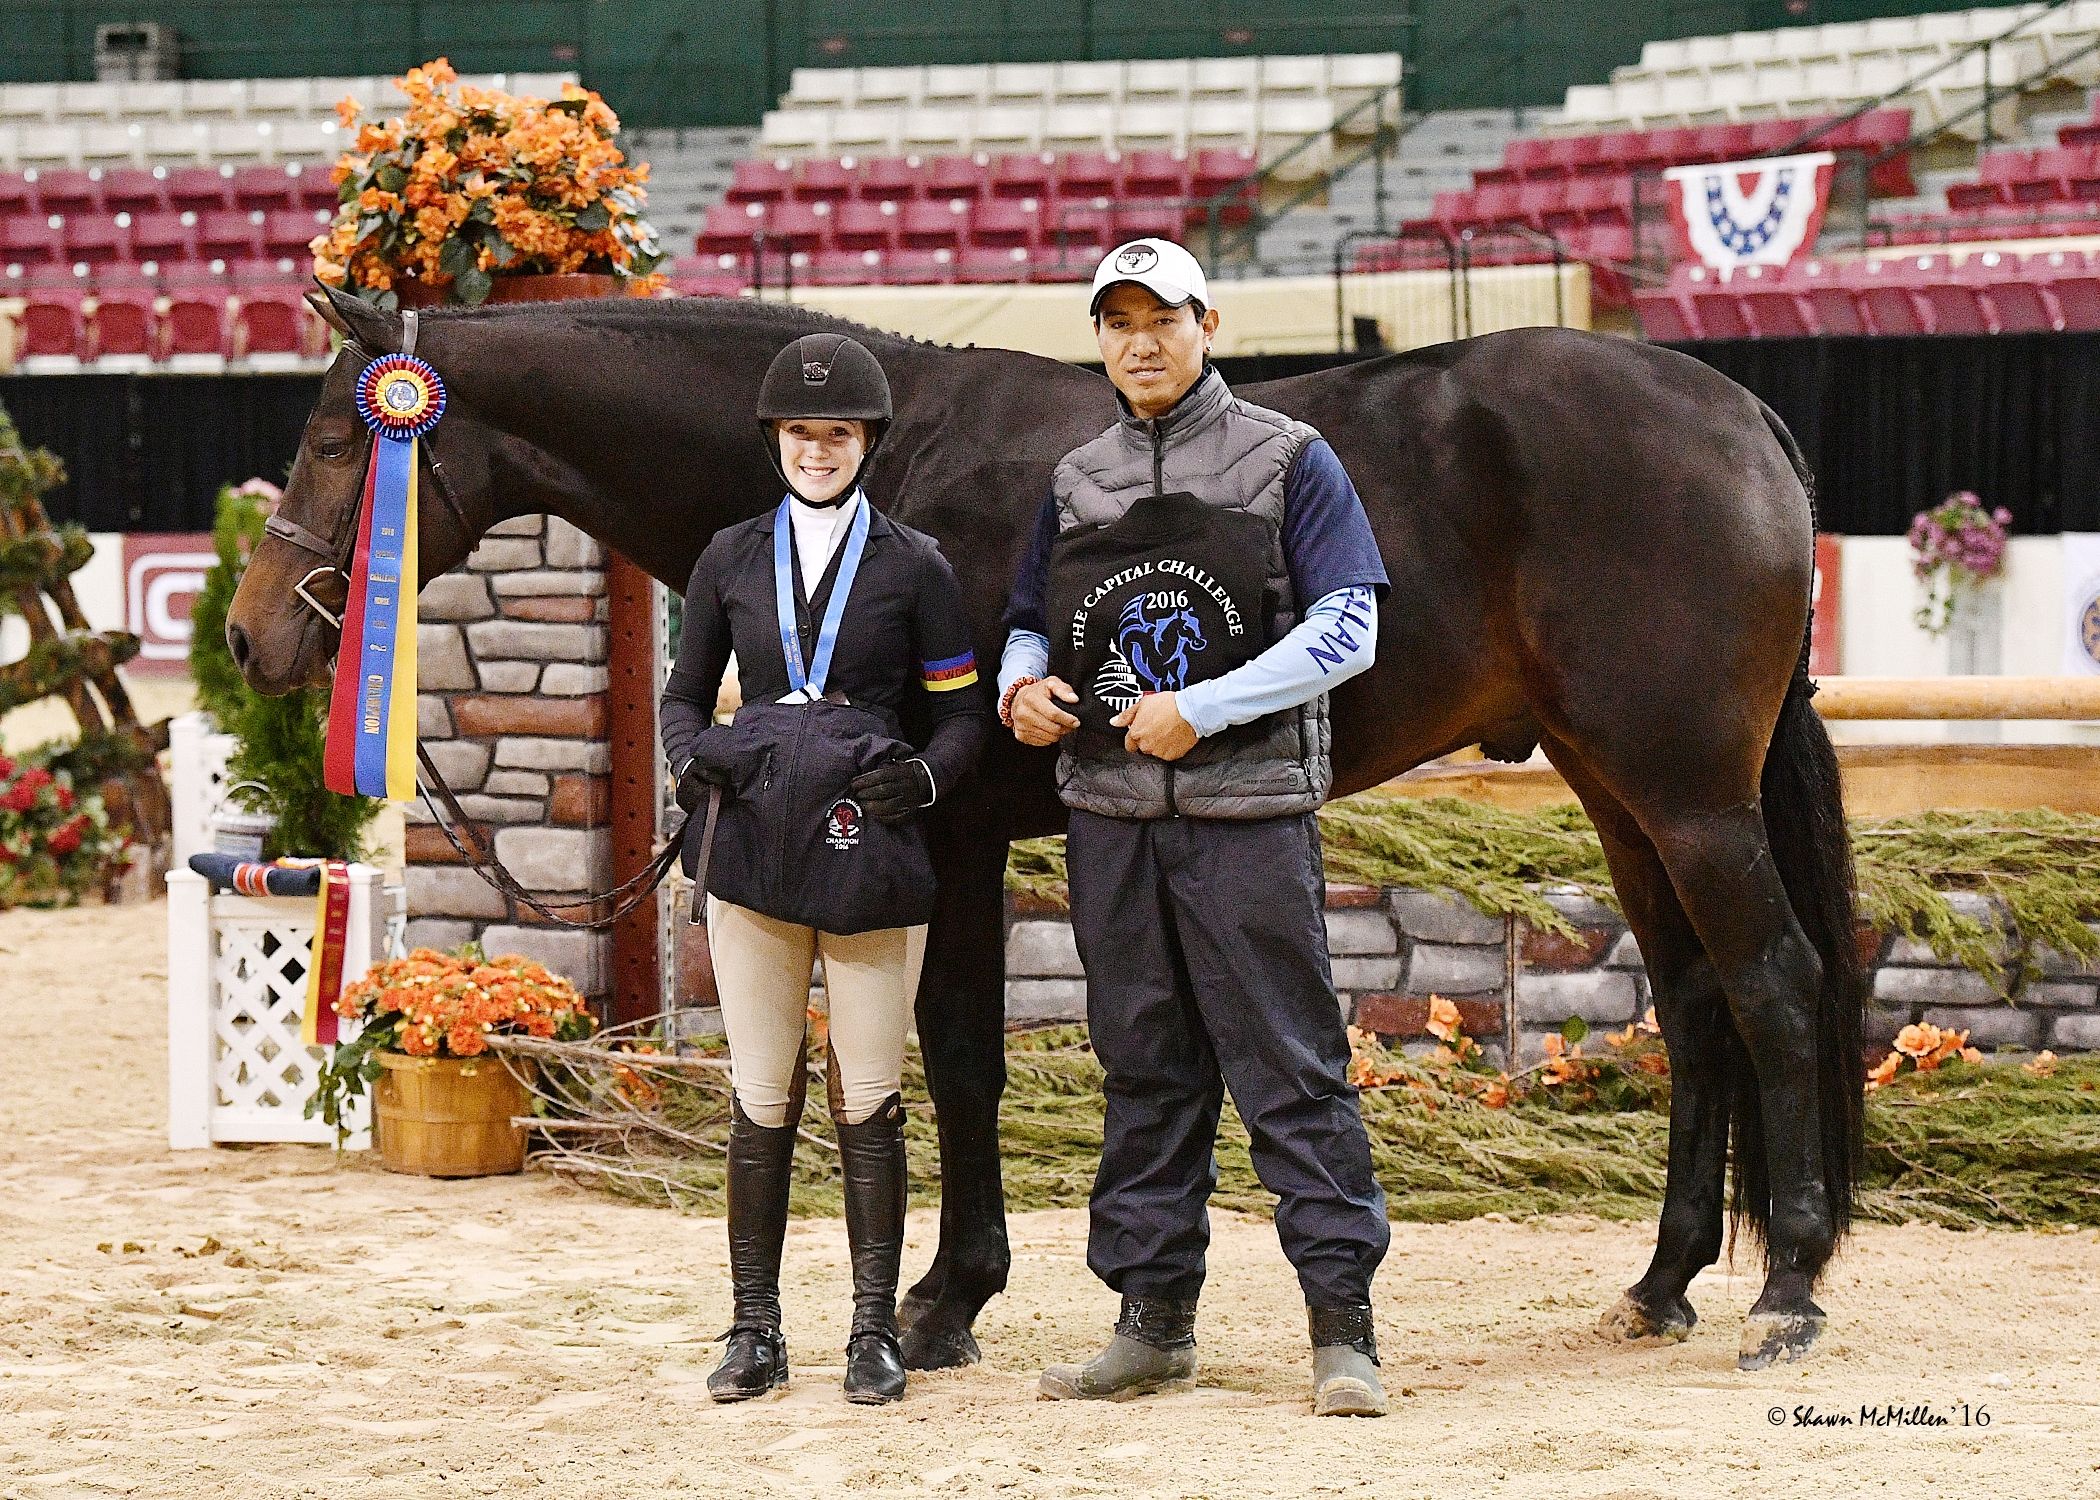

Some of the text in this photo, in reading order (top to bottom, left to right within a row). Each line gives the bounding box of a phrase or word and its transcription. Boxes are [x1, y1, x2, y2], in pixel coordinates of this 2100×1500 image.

[1072, 559, 1244, 650] THE CAPITAL CHALLENGE
[1146, 590, 1189, 609] 2016
